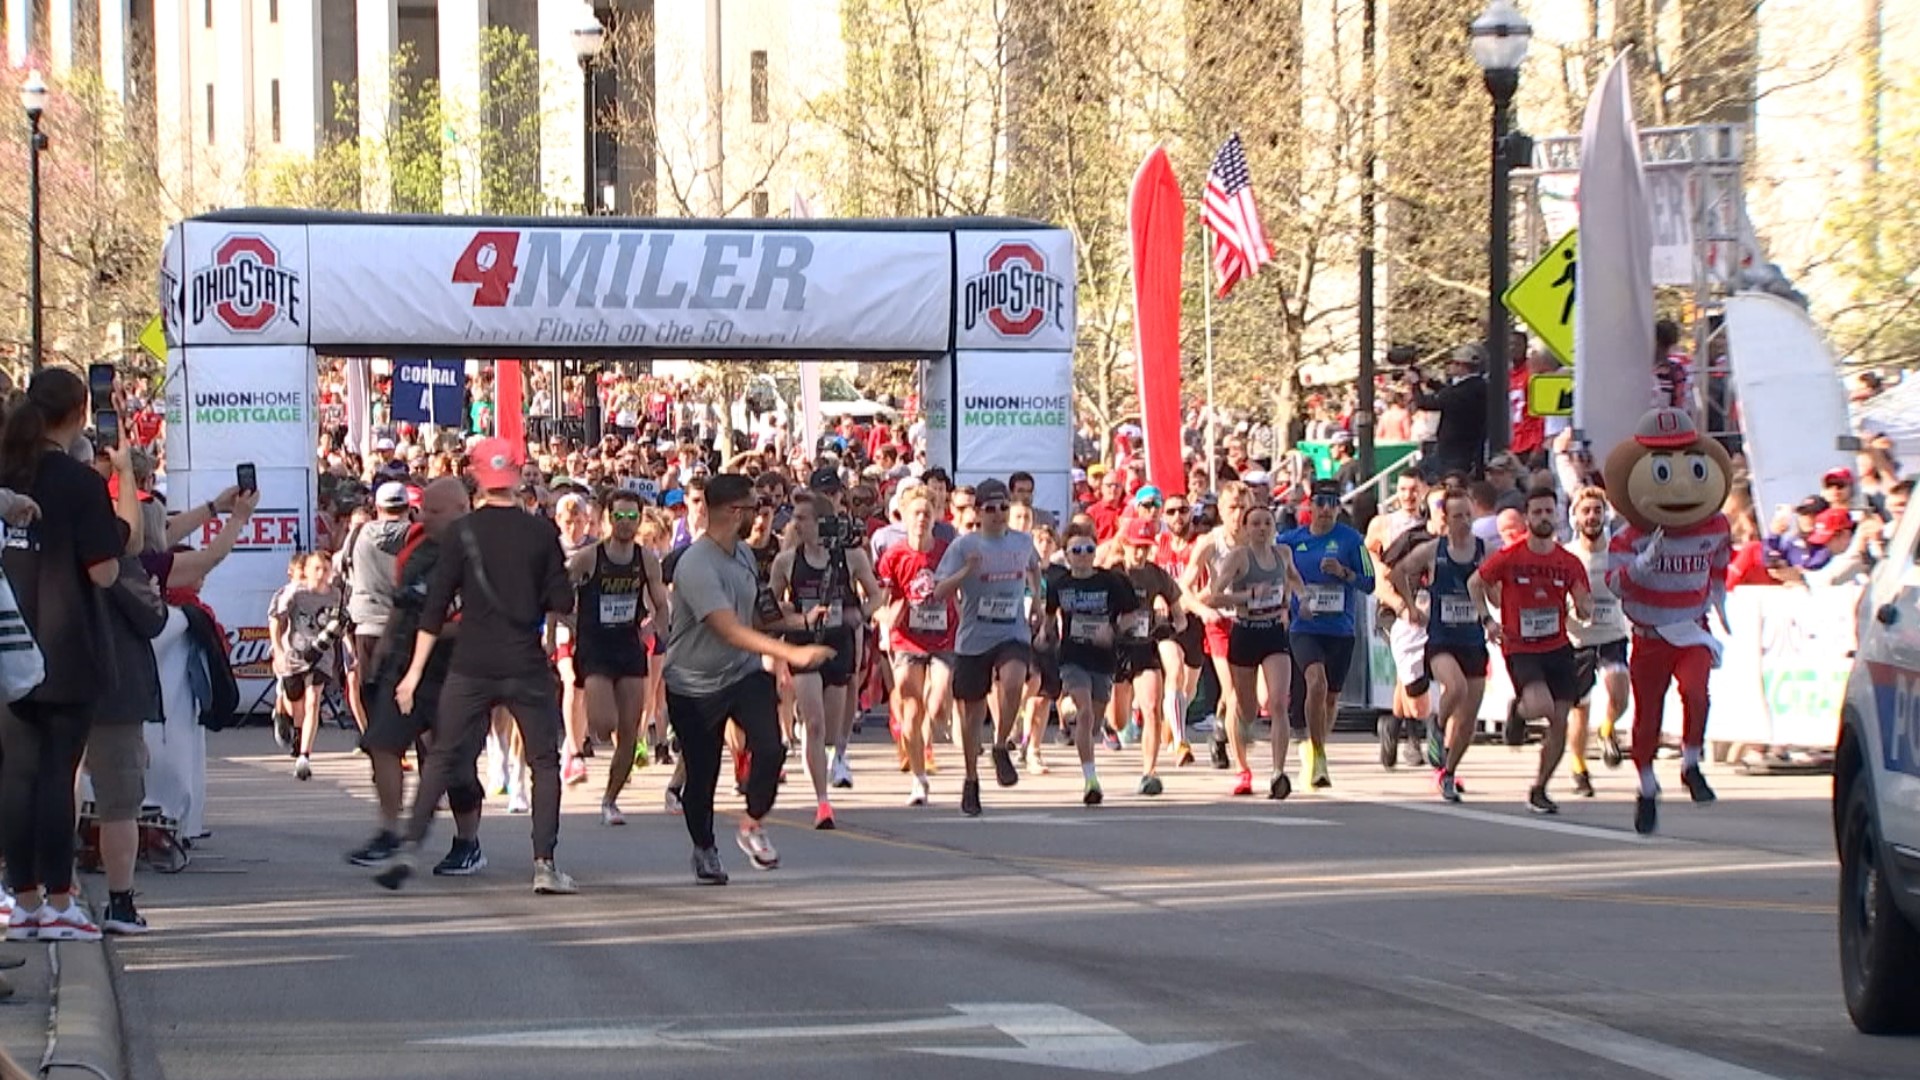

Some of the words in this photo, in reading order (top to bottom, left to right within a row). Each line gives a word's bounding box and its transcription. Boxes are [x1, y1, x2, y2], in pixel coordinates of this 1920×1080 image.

[534, 318, 609, 342] Finish
[617, 325, 646, 342] on
[655, 319, 693, 343] the
[701, 320, 735, 344] 50
[401, 365, 457, 386] CORRAL
[195, 408, 301, 423] MORTGAGE
[964, 411, 1066, 426] MORTGAGE
